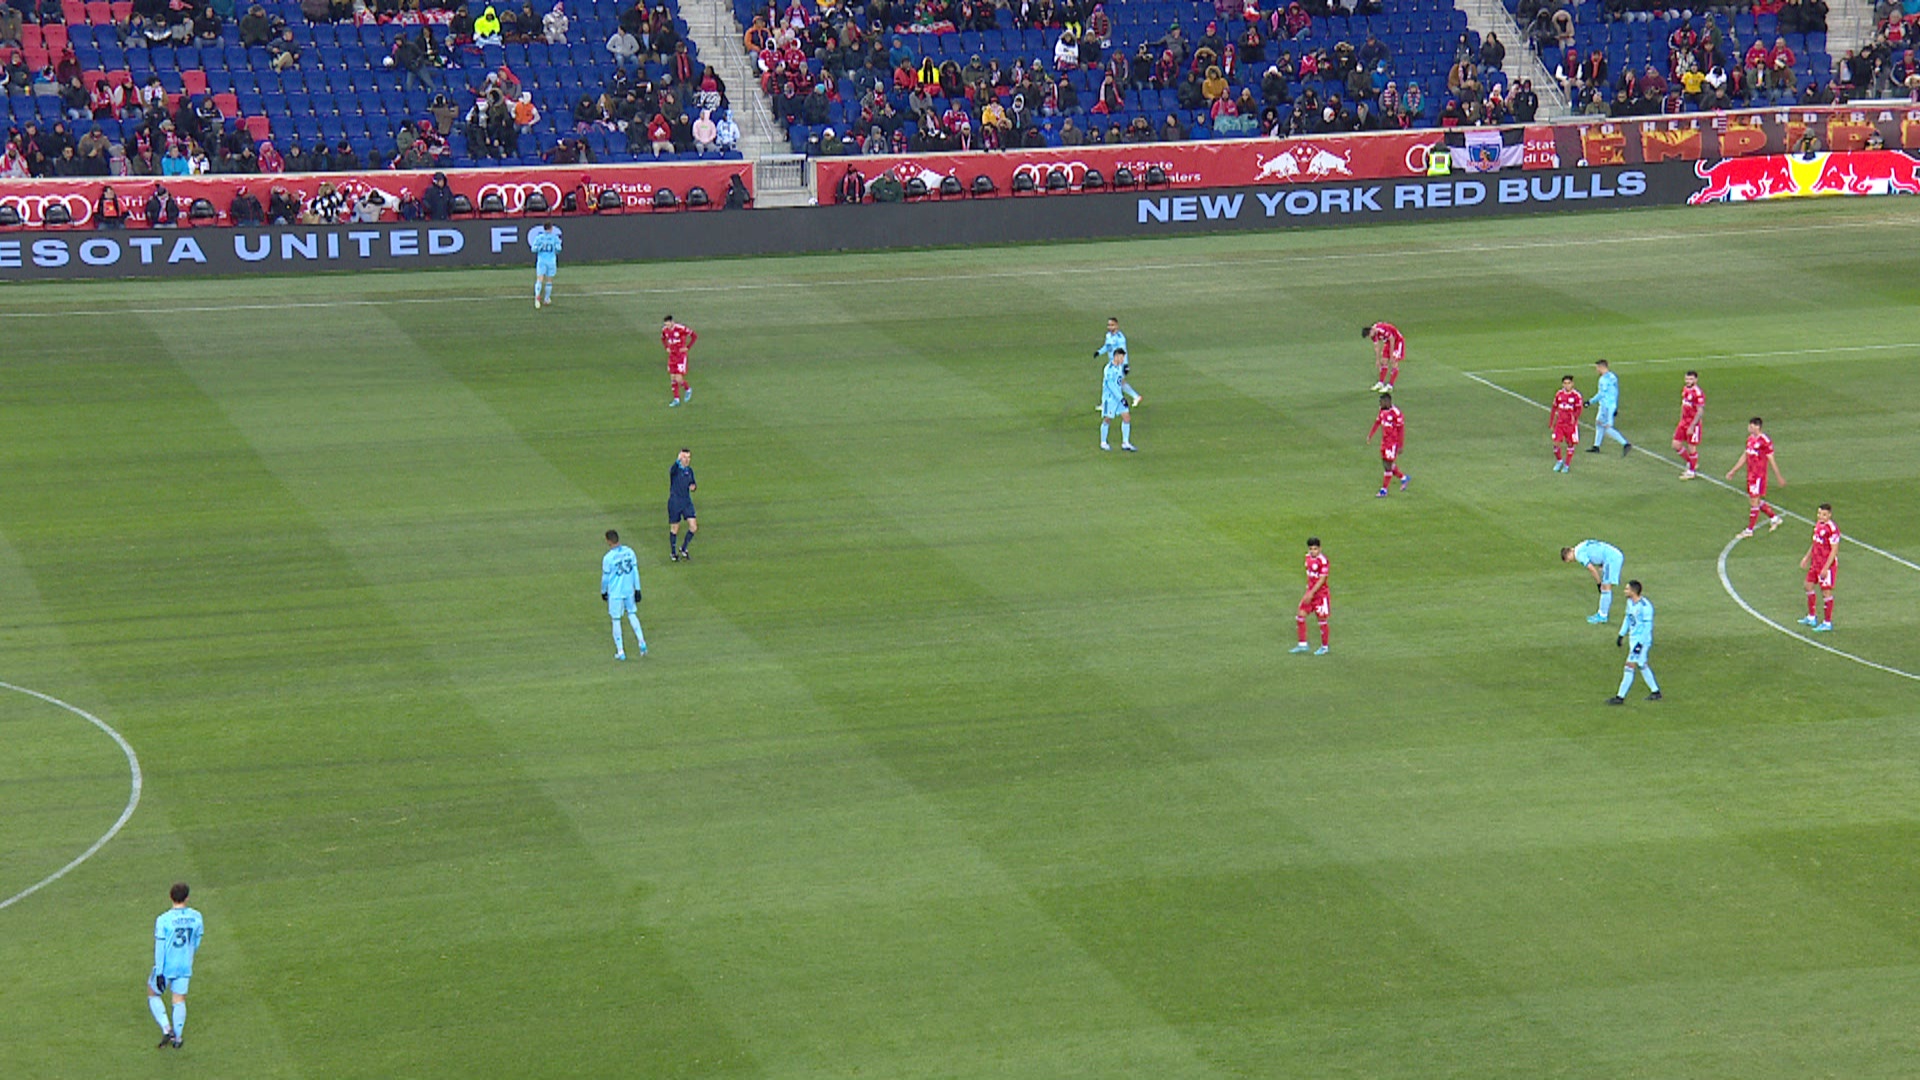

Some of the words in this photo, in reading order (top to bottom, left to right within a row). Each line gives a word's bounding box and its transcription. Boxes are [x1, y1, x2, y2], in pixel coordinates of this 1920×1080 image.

[1578, 125, 1614, 137] TO
[1750, 113, 1818, 125] AND
[1138, 193, 1245, 223] NEW
[1256, 186, 1383, 217] YORK
[1394, 180, 1487, 210] RED
[1498, 171, 1647, 203] BULLS
[233, 228, 465, 262] UNITED
[615, 558, 633, 577] 33
[172, 927, 194, 949] 31
